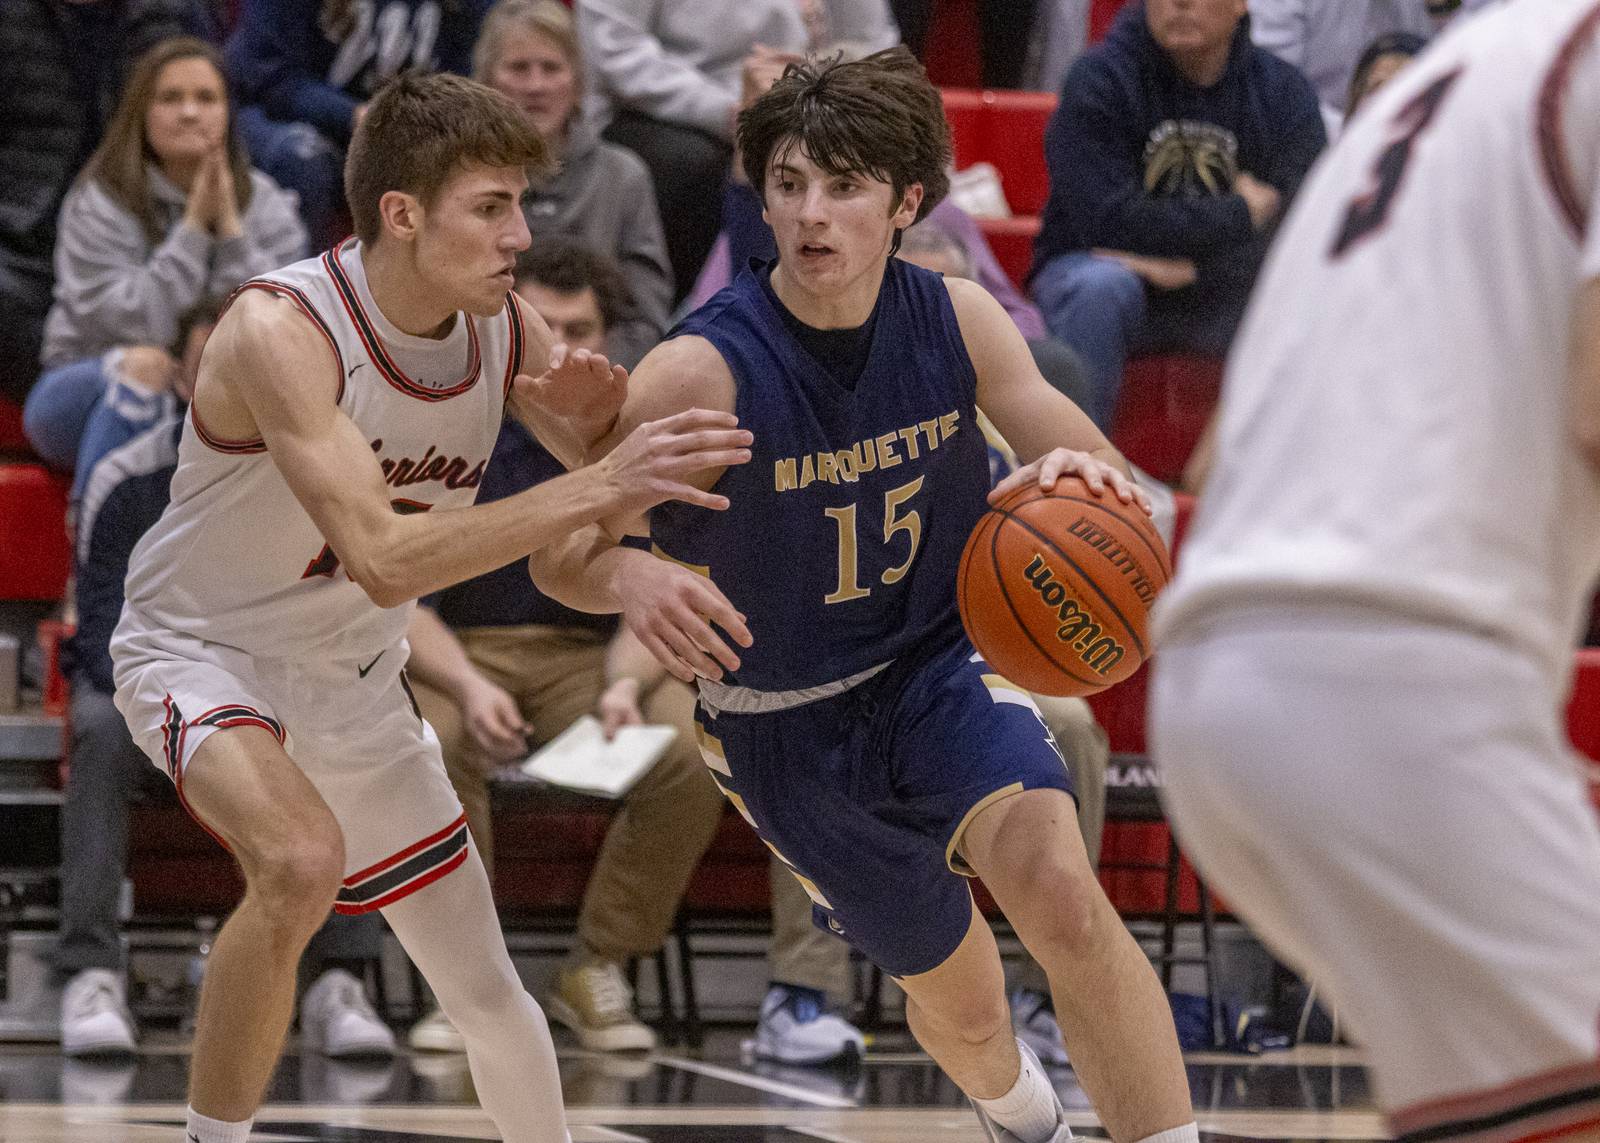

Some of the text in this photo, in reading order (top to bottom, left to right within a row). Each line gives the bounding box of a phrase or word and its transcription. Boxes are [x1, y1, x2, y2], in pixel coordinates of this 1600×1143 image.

[774, 410, 961, 492] MARQUETTE
[823, 473, 926, 605] 15
[1023, 552, 1126, 678] Wilson
